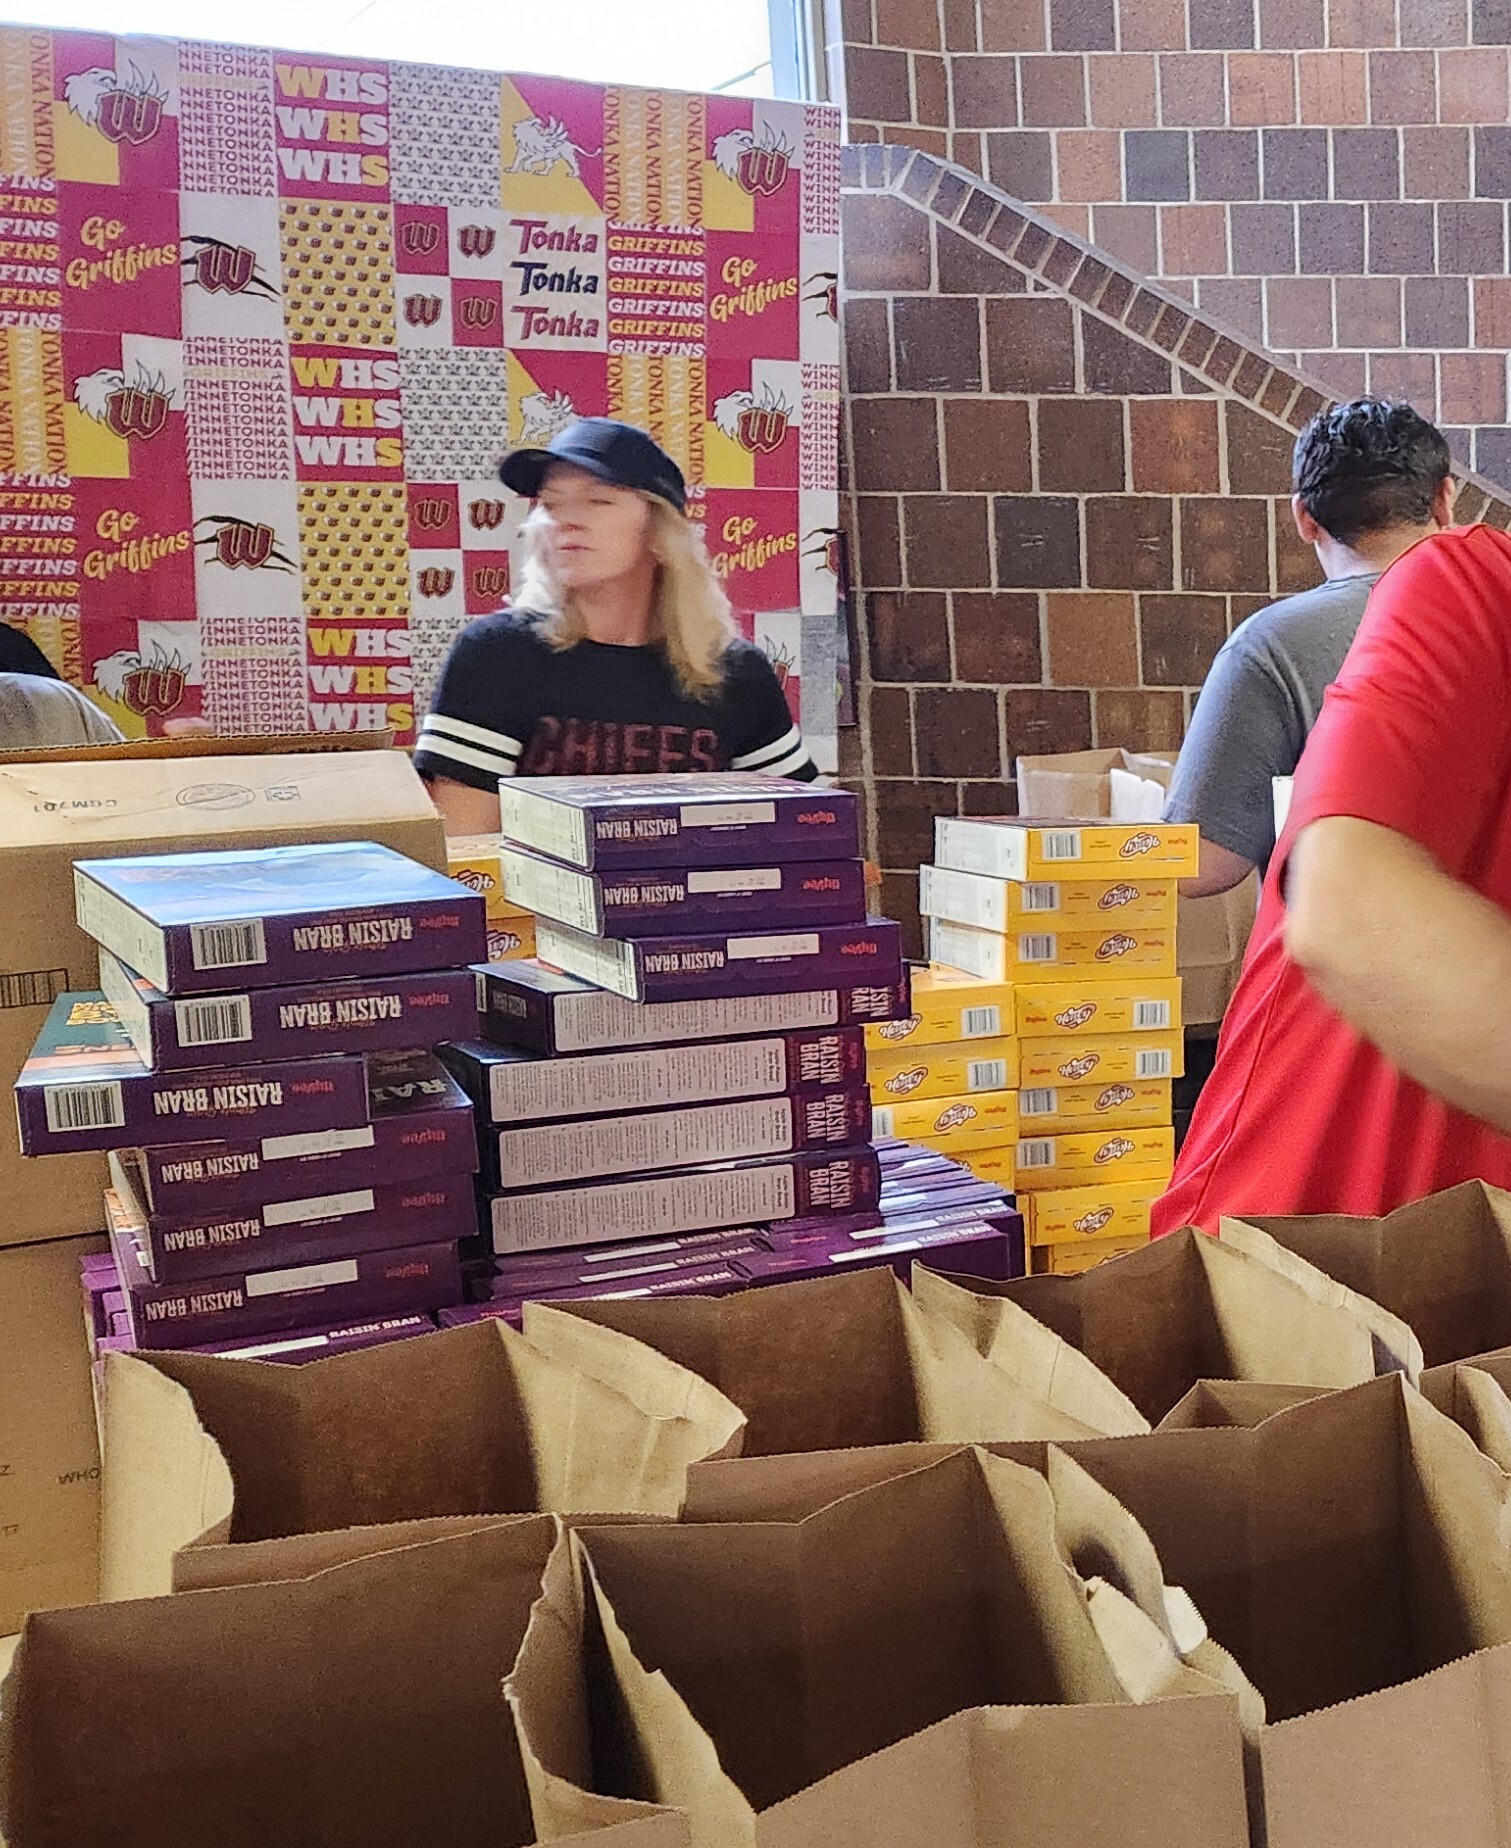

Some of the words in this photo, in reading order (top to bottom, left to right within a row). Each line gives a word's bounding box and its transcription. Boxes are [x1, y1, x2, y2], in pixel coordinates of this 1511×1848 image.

[275, 64, 389, 105] WHS
[275, 106, 389, 145] WHS
[277, 147, 390, 186] WHS
[80, 216, 126, 250] Go
[509, 219, 599, 255] Tonka
[608, 236, 705, 256] GRIFFINS
[66, 243, 178, 290] Griffins
[510, 261, 599, 296] Tonka
[722, 256, 757, 286] Go
[608, 277, 705, 297] GRIFFINS
[710, 276, 798, 323] Griffins
[510, 305, 599, 340] Tonka
[609, 319, 705, 338] GRIFFINS
[183, 356, 285, 369] INNETONKA
[609, 339, 706, 357] GRIFFINS
[290, 357, 401, 390] WHS
[292, 396, 401, 428] WHS
[295, 436, 403, 467] WHS
[96, 509, 139, 542] Go
[723, 516, 758, 544] Go
[84, 530, 190, 580] Griffins
[712, 532, 797, 578] Griffins
[307, 628, 412, 657] WHS
[308, 665, 412, 694] WHS
[308, 702, 413, 731] WHS
[521, 715, 719, 775] CHIEFS
[596, 820, 631, 840] BRAN
[635, 818, 678, 837] RAISIN
[604, 886, 640, 906] BRAN
[641, 884, 685, 903] RAISIN
[293, 924, 344, 951] BRAN
[349, 916, 413, 946] RAISIN
[645, 953, 680, 973] BRAN
[682, 951, 725, 970] RAISIN
[280, 1001, 331, 1029] BRAN
[336, 995, 403, 1021] RAISIN
[800, 1043, 820, 1081] BRAN
[819, 1035, 840, 1084] RAISIN
[153, 1088, 210, 1115] BRAN
[213, 1080, 283, 1109] RAISIN
[806, 1101, 826, 1139] BRAN
[825, 1094, 847, 1142] RAISIN
[162, 1161, 205, 1184] BRAN
[207, 1152, 260, 1177] RAISIN
[809, 1168, 830, 1206] BRAN
[829, 1160, 850, 1209] RAISIN
[164, 1229, 206, 1252] BRAN
[208, 1218, 261, 1244] RAISIN
[146, 1298, 188, 1321] BRAN
[191, 1289, 243, 1314] RAISIN
[329, 1323, 380, 1338] RAISIN
[381, 1315, 421, 1329] BRAN
